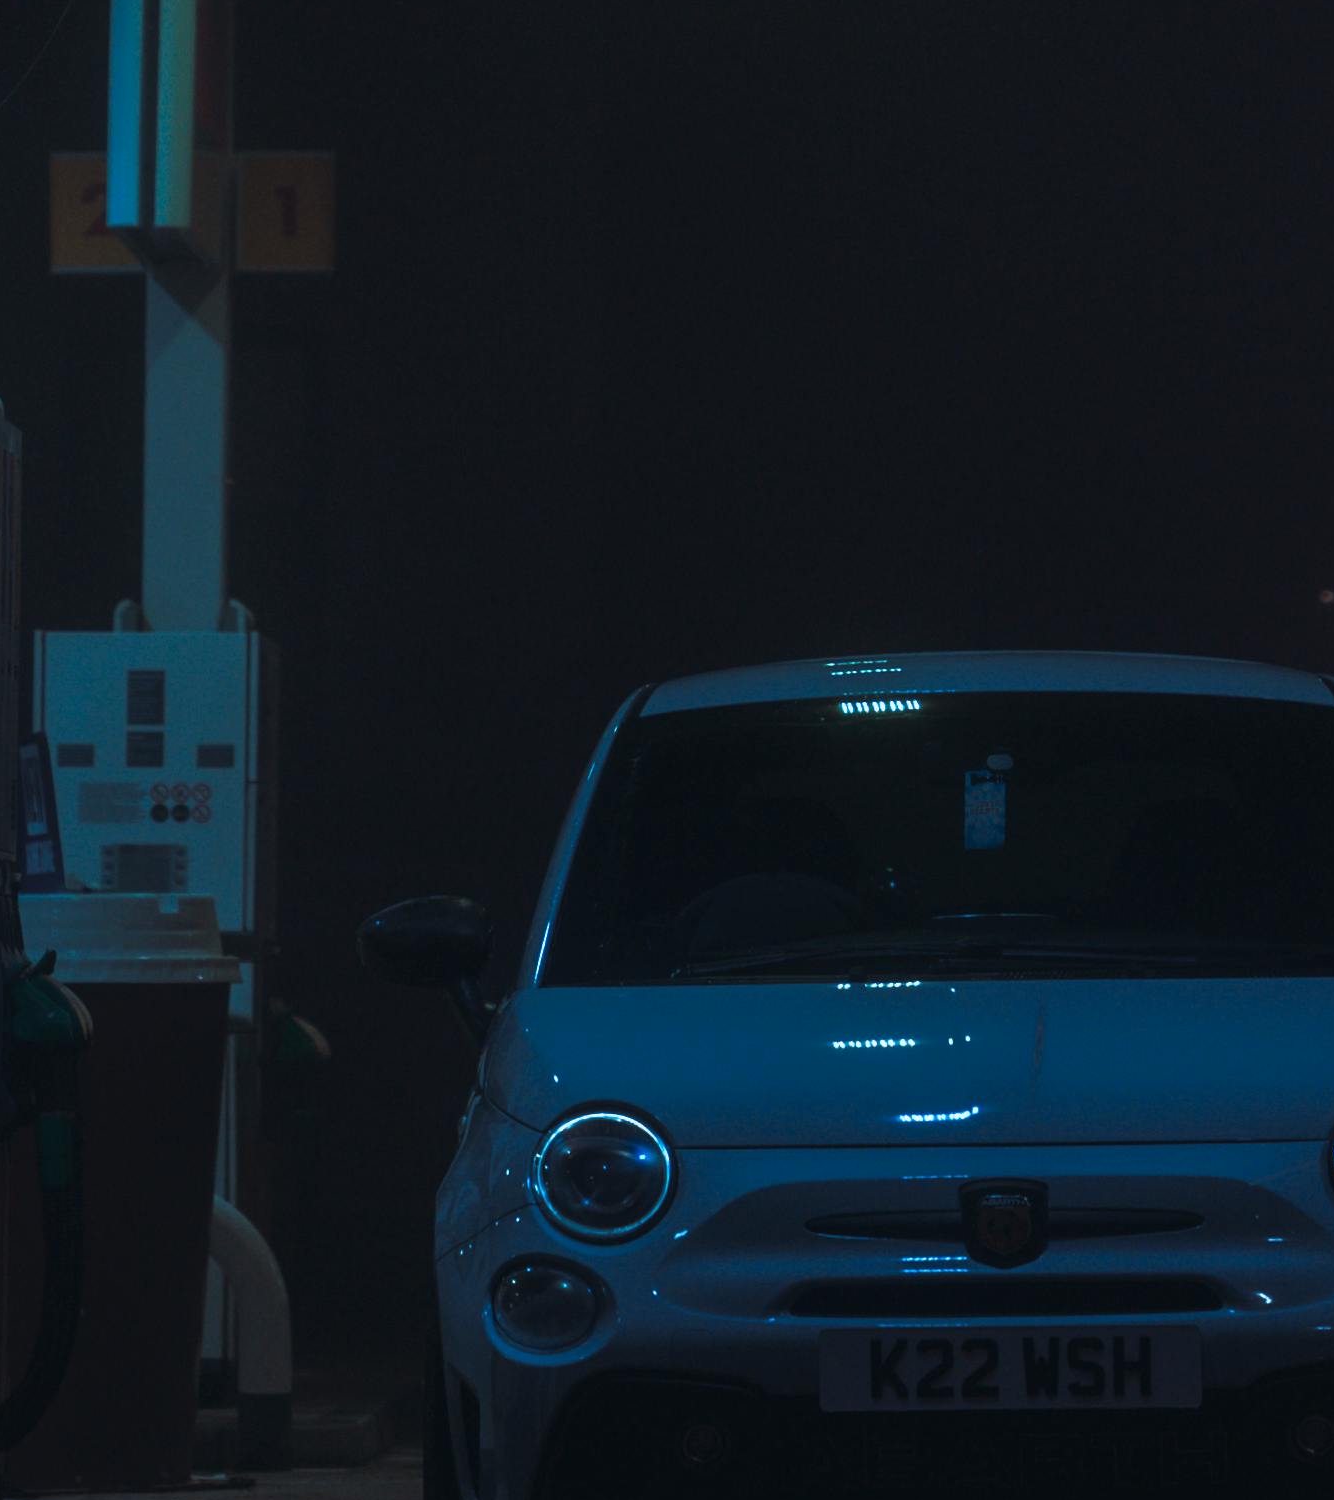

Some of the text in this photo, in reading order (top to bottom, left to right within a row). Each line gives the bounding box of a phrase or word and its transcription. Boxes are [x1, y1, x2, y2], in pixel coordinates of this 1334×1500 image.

[274, 183, 299, 237] 1
[869, 1335, 1152, 1401] K22 WSH
